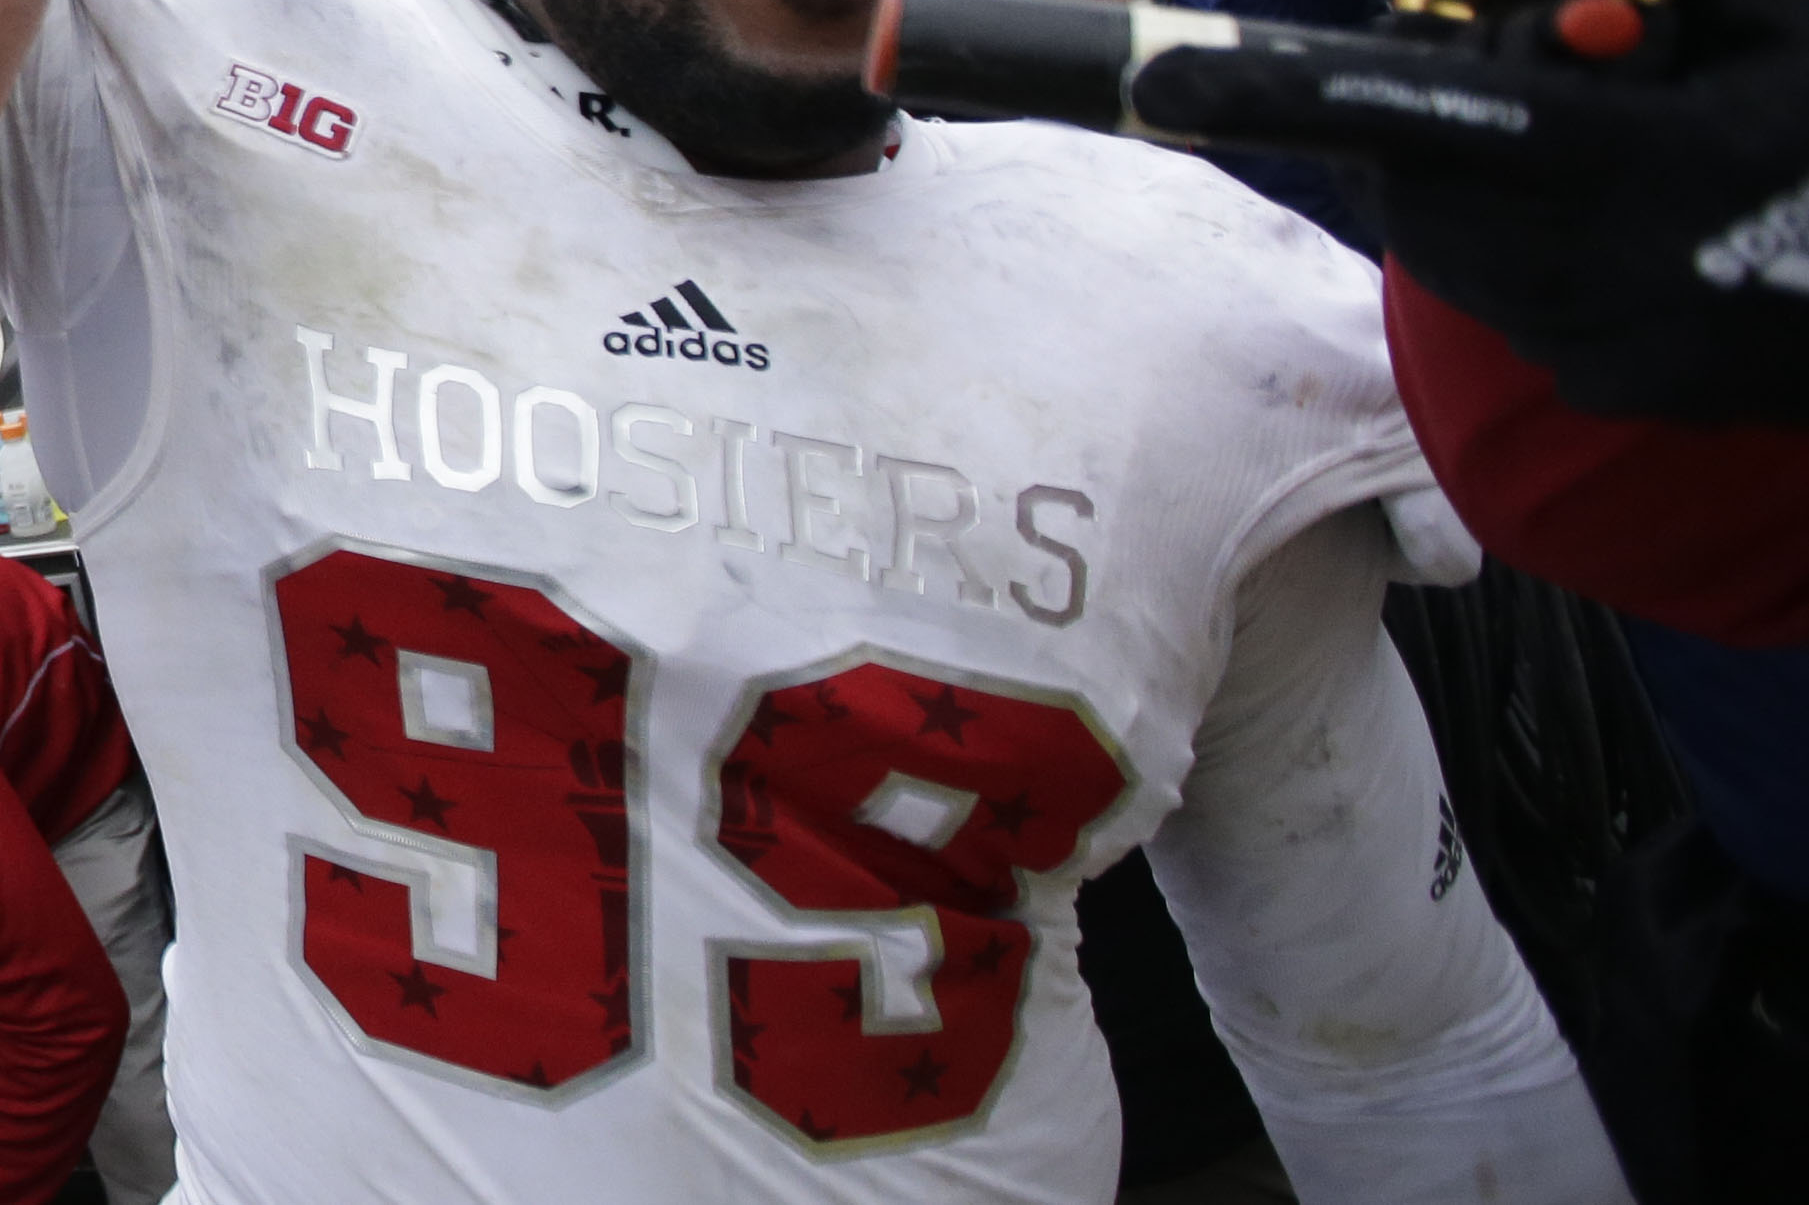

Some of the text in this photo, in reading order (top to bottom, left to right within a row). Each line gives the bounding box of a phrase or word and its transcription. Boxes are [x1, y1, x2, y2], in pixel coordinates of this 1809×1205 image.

[295, 323, 1098, 630] HOOSIERS
[603, 326, 771, 371] adidas
[259, 531, 1145, 1163] 99
